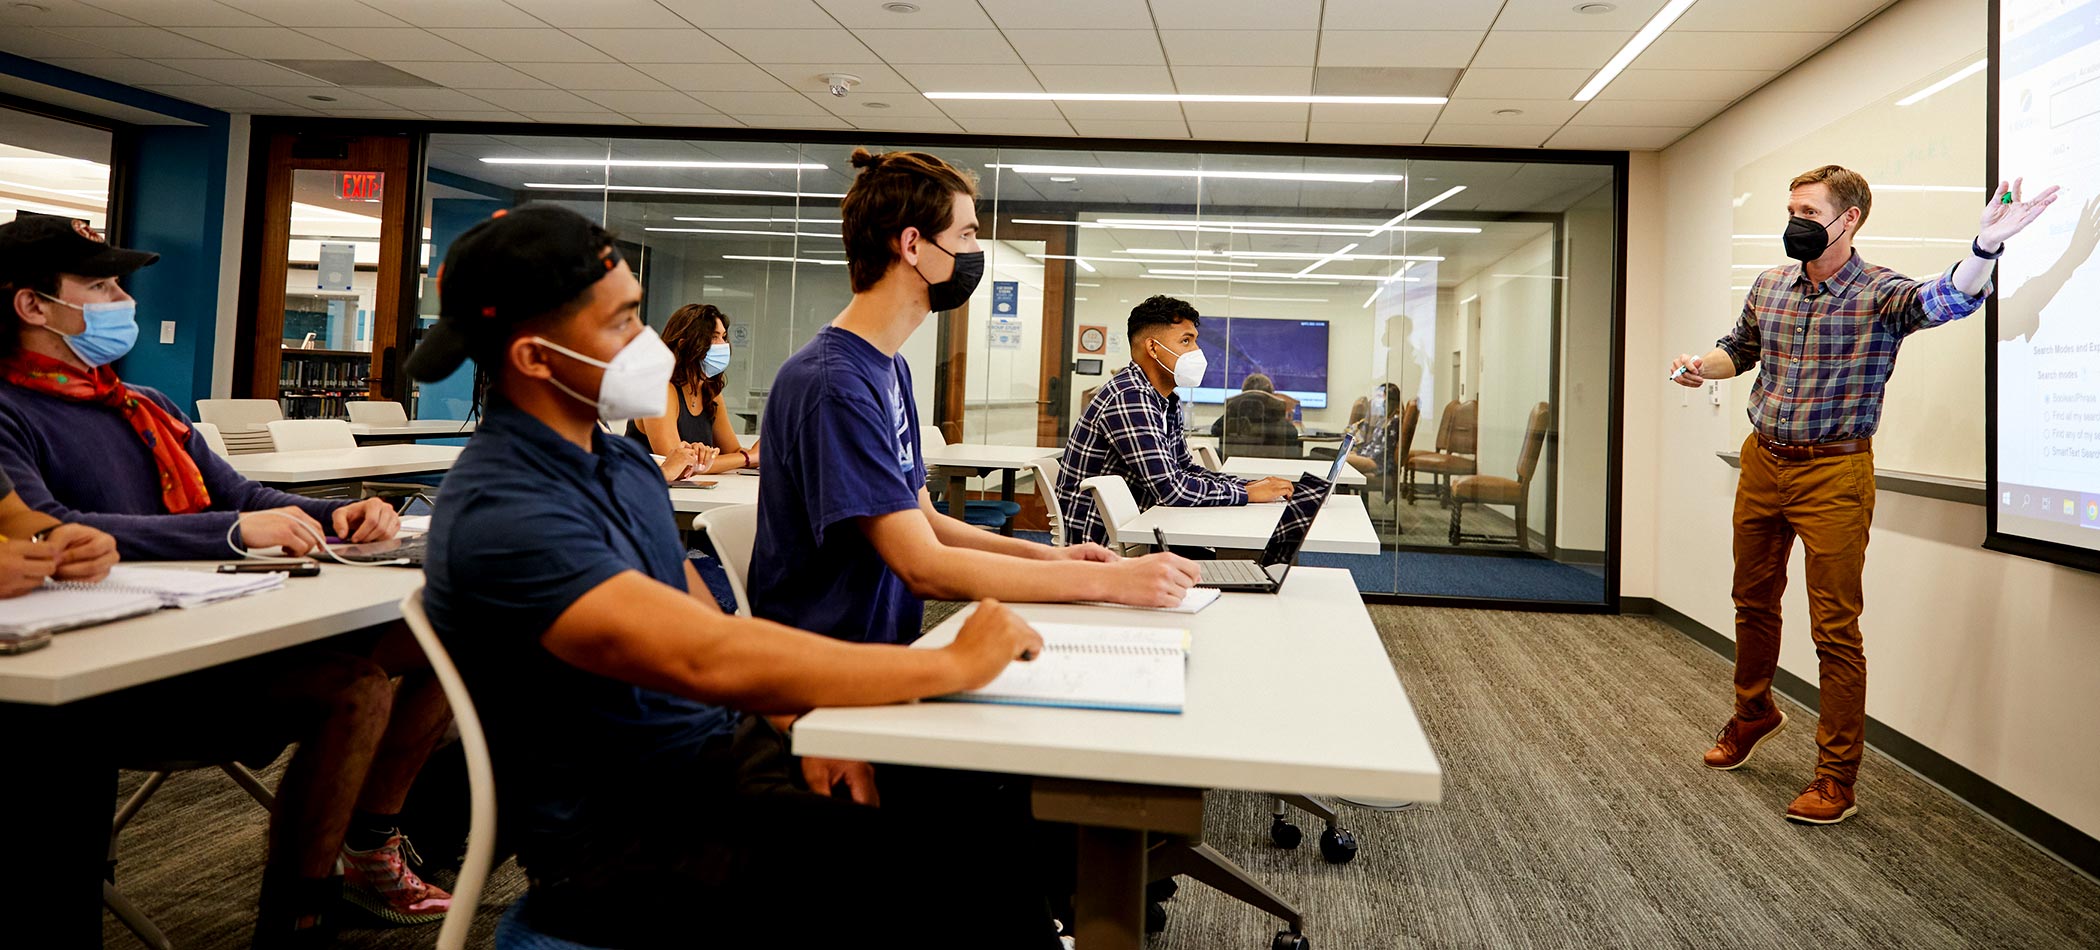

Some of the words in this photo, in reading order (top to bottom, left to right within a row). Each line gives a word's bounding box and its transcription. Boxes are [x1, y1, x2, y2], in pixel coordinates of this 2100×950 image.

[343, 173, 377, 199] EXIT
[2033, 344, 2054, 355] Search
[2055, 343, 2074, 354] Modes
[2076, 342, 2088, 353] and
[2037, 370, 2057, 380] Search
[2058, 369, 2078, 379] modes
[2052, 410, 2065, 421] Find
[2052, 428, 2065, 439] Find
